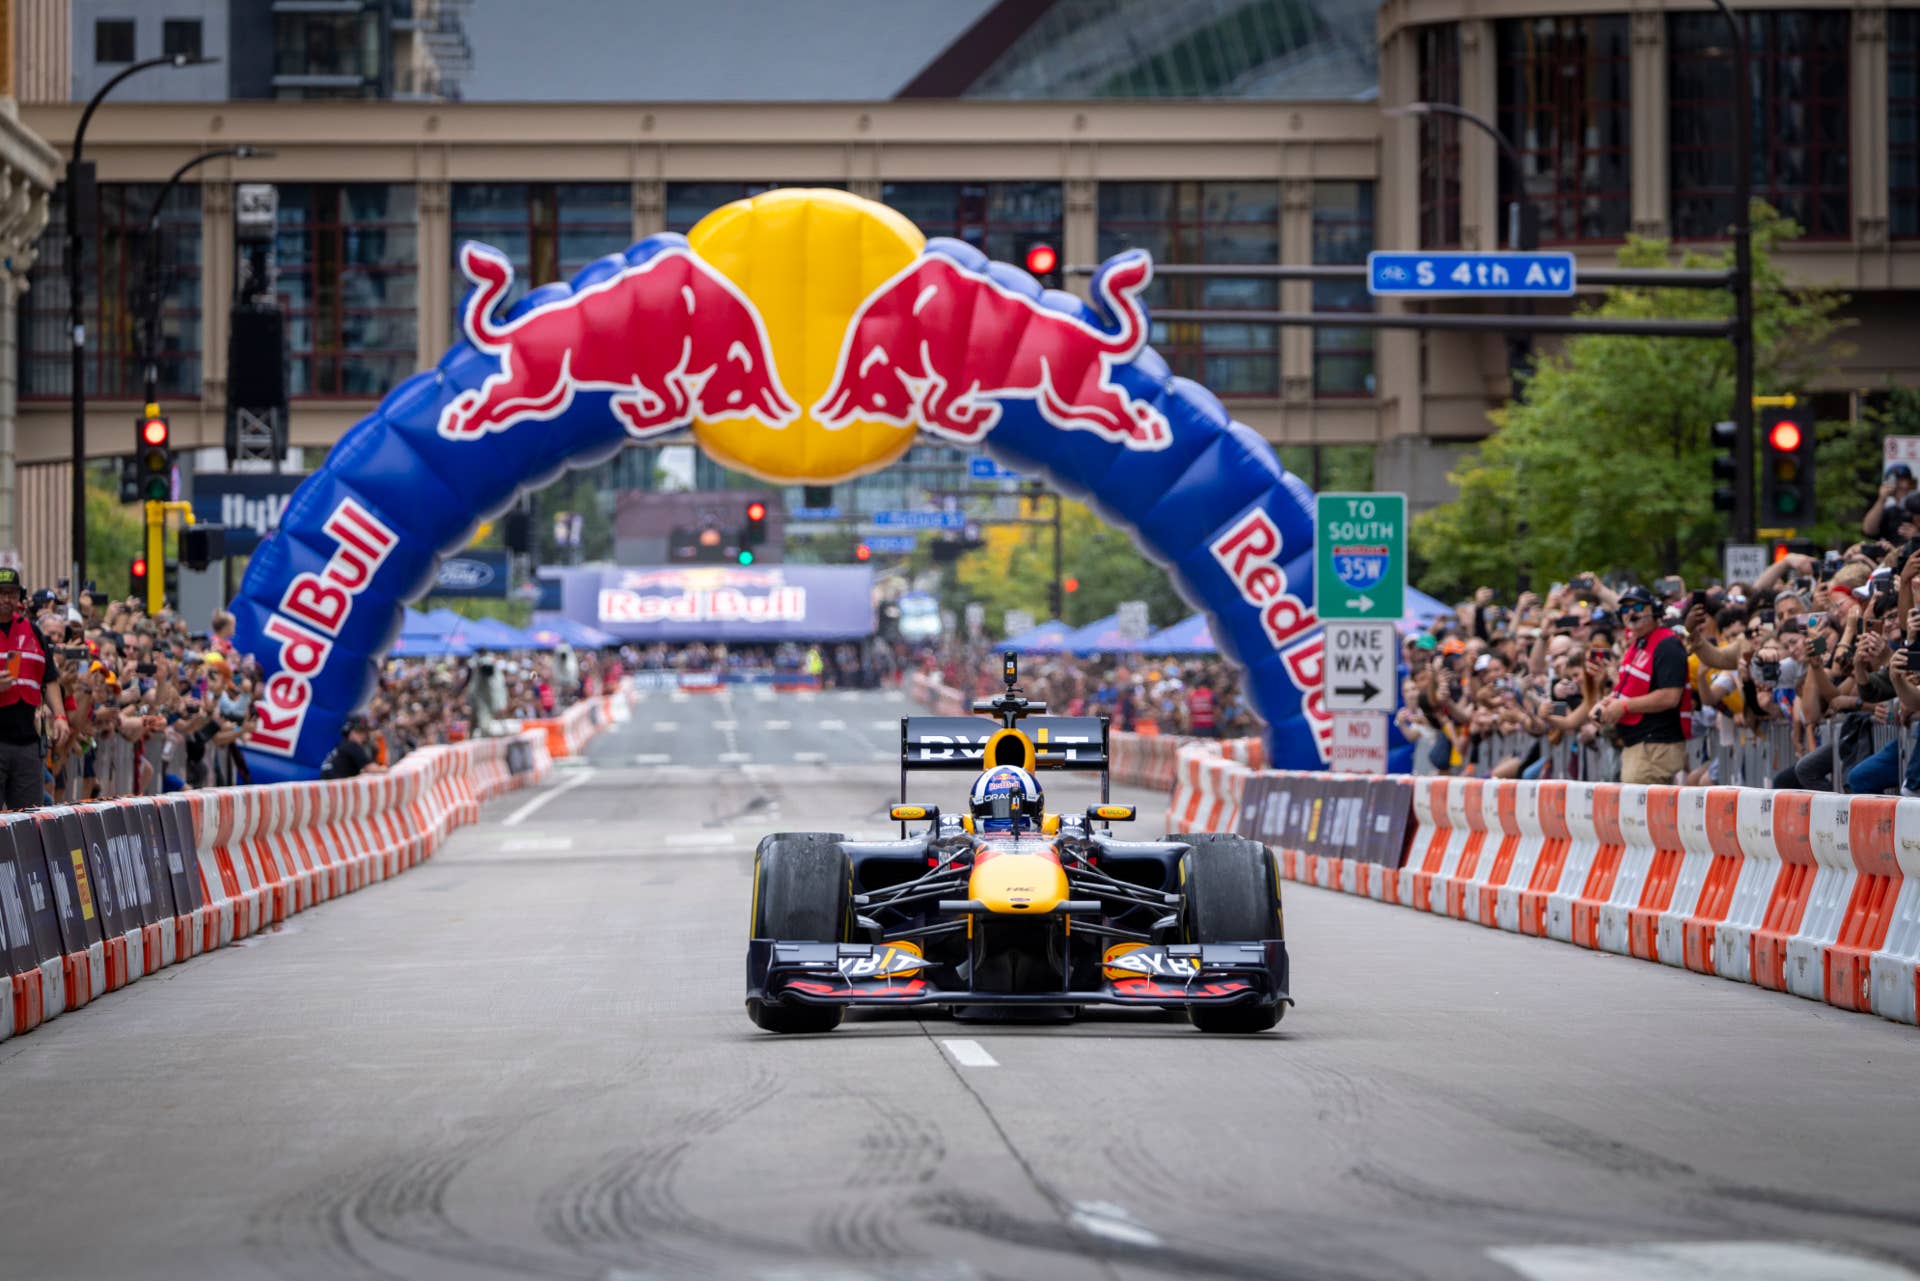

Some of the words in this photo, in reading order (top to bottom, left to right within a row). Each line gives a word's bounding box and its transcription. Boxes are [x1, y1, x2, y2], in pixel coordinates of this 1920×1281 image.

[1416, 260, 1436, 287] S
[1450, 261, 1510, 286] 4th
[1524, 261, 1566, 286] Av
[1347, 500, 1376, 520] TO
[1328, 521, 1394, 541] SOUTH
[278, 496, 399, 638] Bull
[1339, 557, 1382, 580] 35W
[1209, 507, 1317, 649] Red
[598, 588, 698, 622] Red
[706, 586, 806, 621] Bull
[1336, 630, 1381, 650] ONE
[1335, 654, 1384, 673] WAY
[238, 614, 334, 758] Red
[1348, 721, 1371, 739] NO
[1336, 746, 1384, 760] STOPPING
[984, 793, 1026, 802] ORACE
